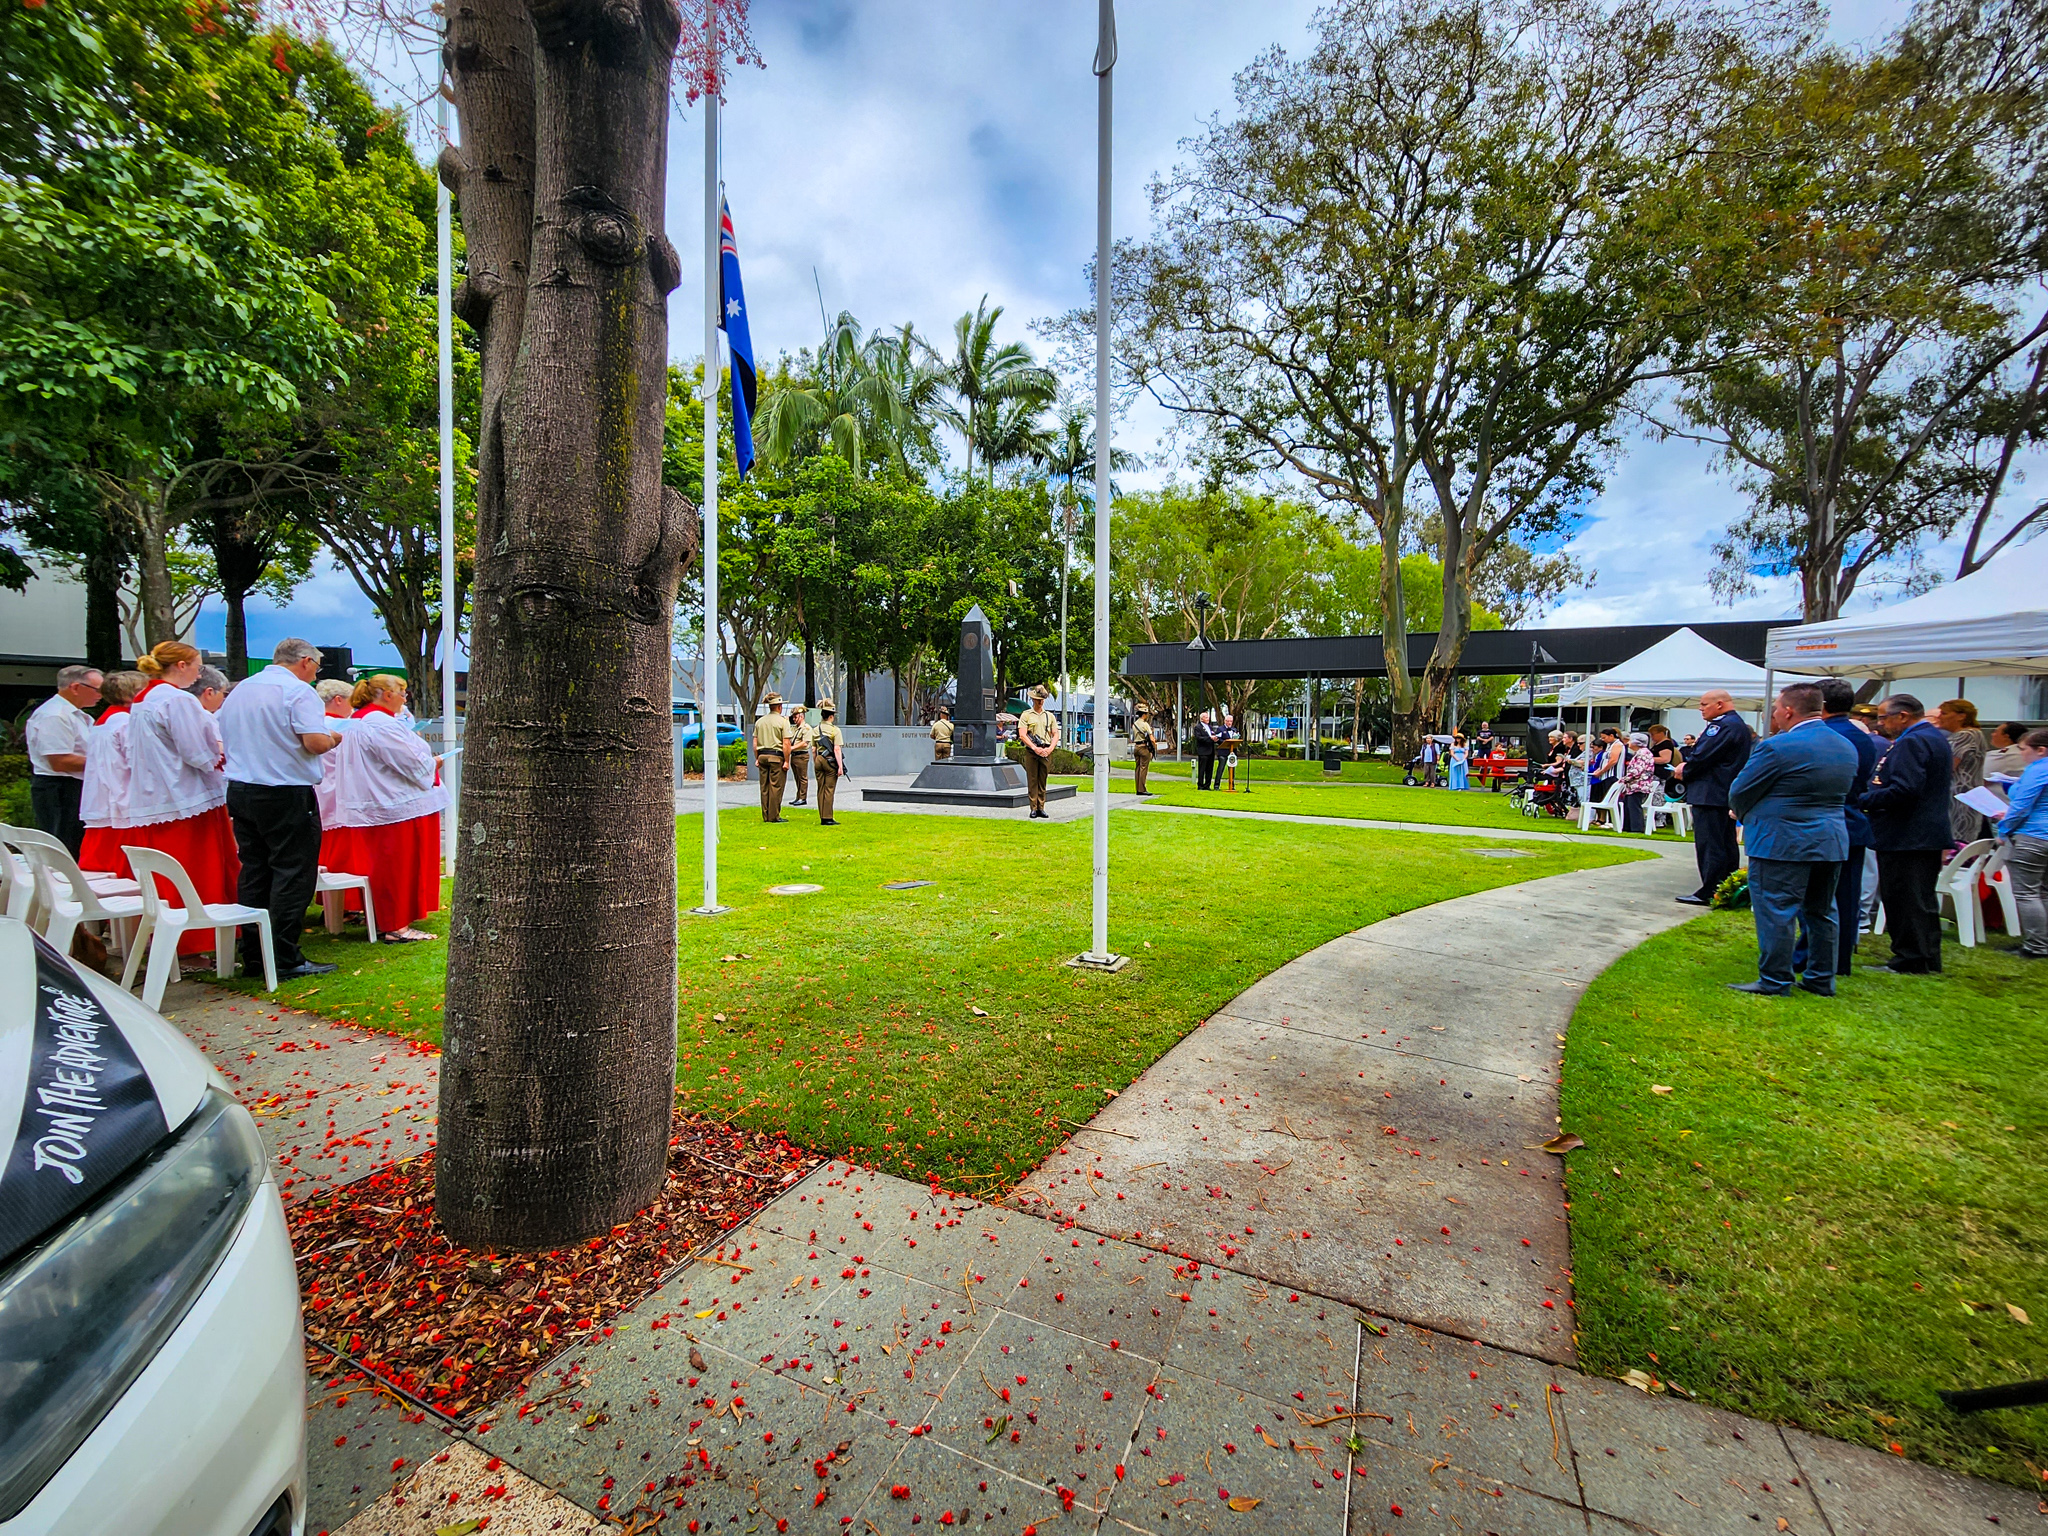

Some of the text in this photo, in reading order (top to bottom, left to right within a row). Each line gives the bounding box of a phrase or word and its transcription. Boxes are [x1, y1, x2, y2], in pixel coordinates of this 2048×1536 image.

[33, 994, 109, 1185] JOIN THE ADVENTURE
